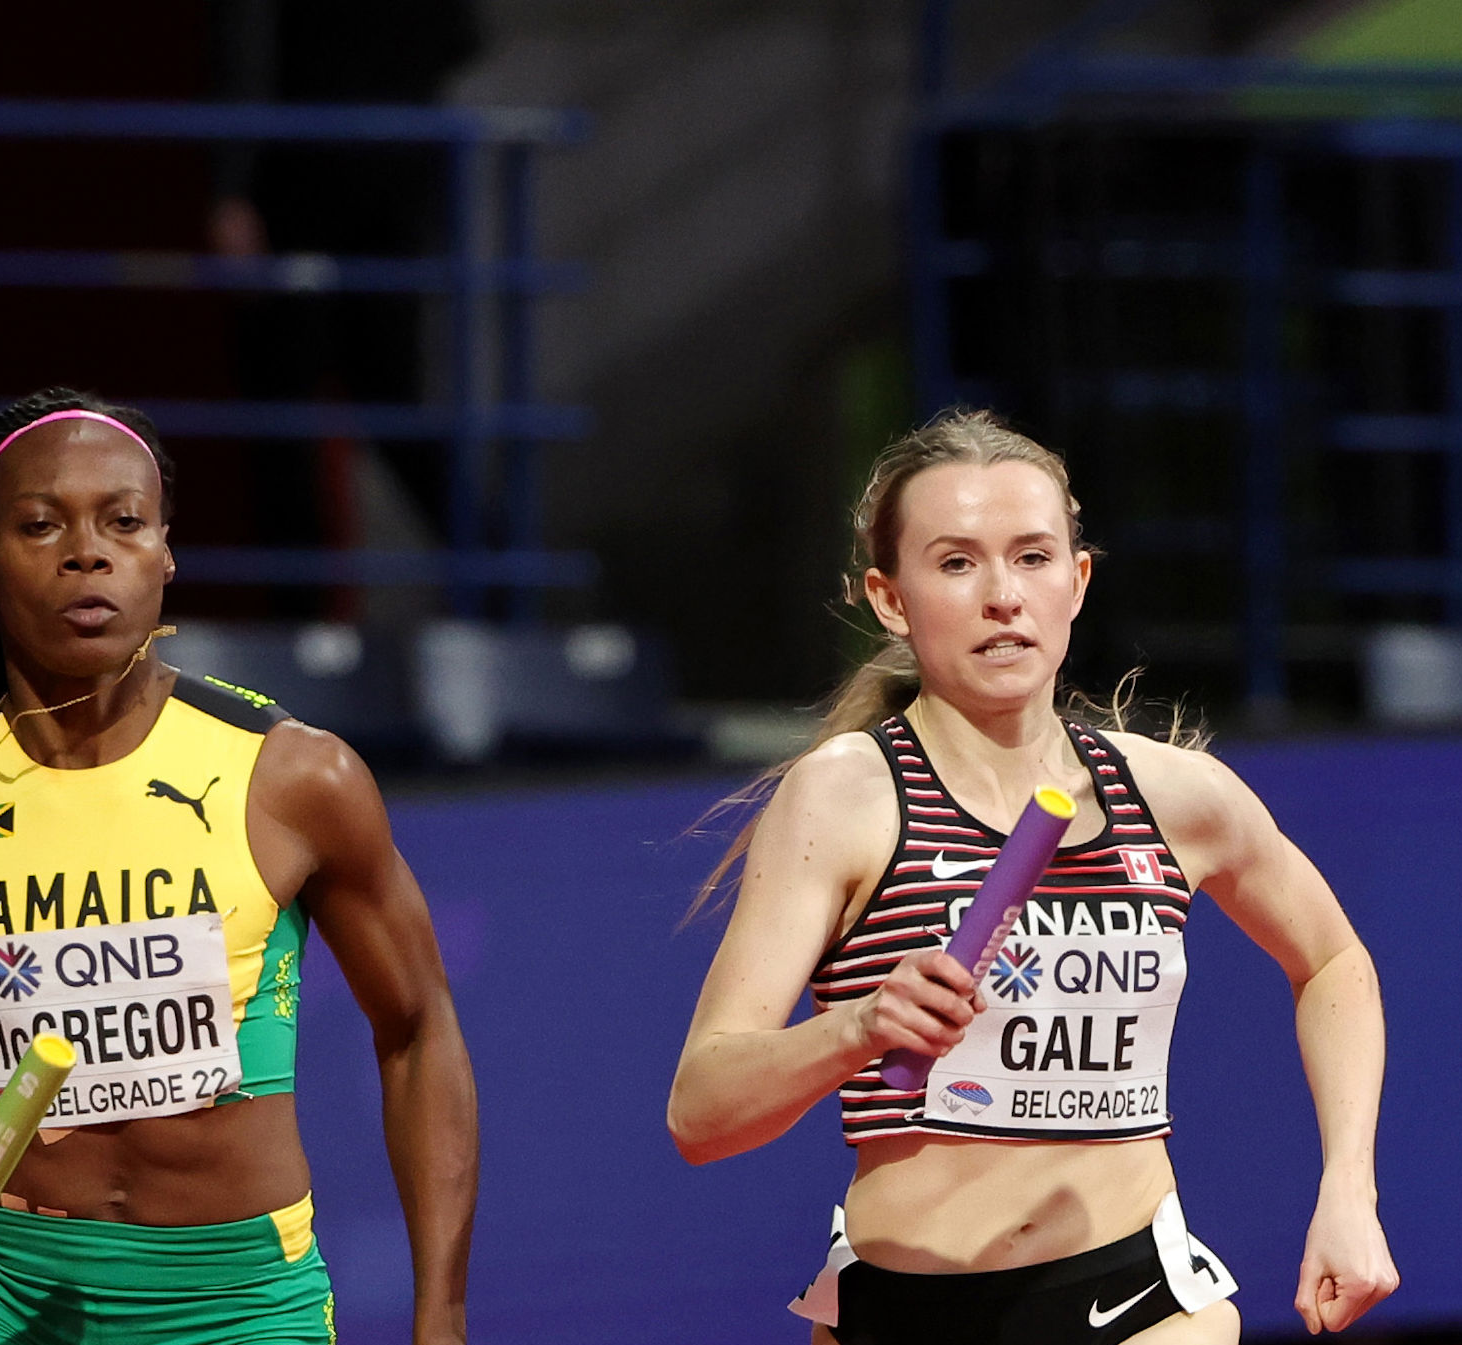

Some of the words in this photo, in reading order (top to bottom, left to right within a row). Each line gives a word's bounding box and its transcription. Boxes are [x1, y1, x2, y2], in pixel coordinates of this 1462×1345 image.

[949, 897, 1165, 936] CNADA
[55, 933, 184, 988] QNB
[1053, 949, 1161, 995] QNB
[1000, 1014, 1139, 1072] GALE
[192, 1066, 228, 1100] 22
[1011, 1088, 1137, 1120] BELGRADE
[1140, 1084, 1160, 1115] 22
